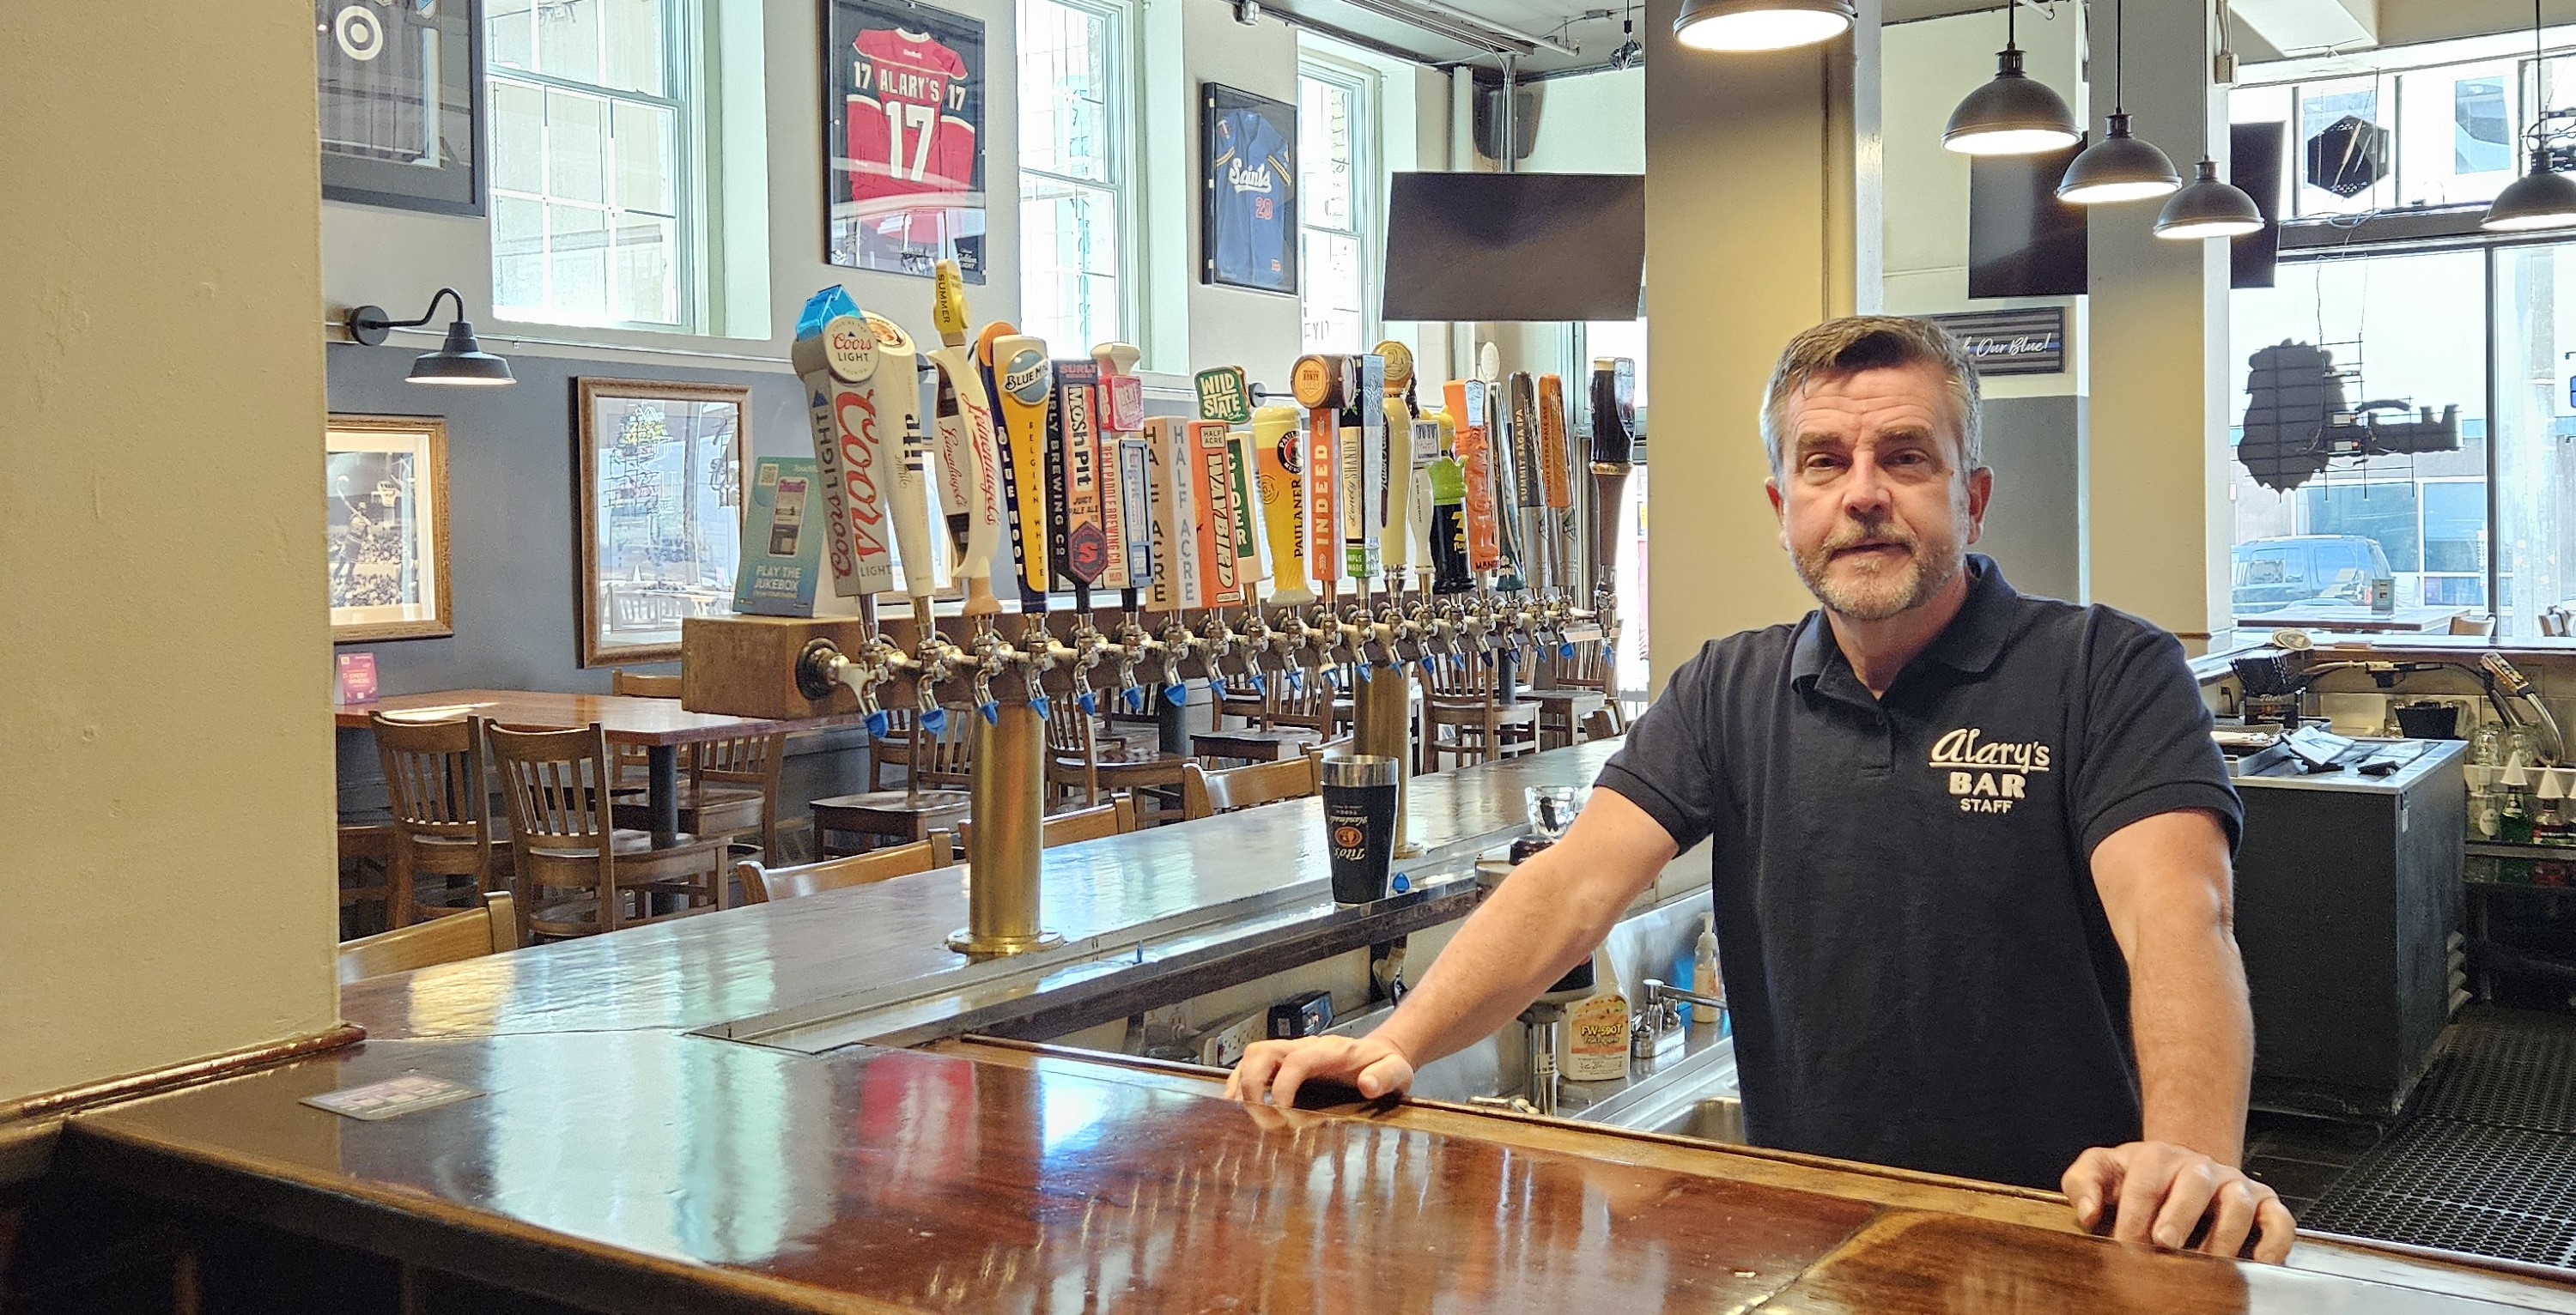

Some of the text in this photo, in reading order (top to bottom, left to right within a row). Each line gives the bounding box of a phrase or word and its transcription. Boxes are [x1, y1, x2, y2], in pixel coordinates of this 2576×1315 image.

[854, 61, 872, 90] 17
[879, 69, 939, 102] ALARY'S
[948, 84, 966, 112] 17
[885, 100, 935, 182] 17
[1229, 158, 1272, 193] Saints
[1255, 197, 1273, 220] 20
[938, 274, 951, 324] SUMMER
[831, 332, 872, 350] Coors
[1976, 338, 2008, 357] Our
[2008, 332, 2051, 356] Blue!
[838, 353, 869, 361] LIGHT
[1059, 363, 1097, 374] SURLY
[1005, 371, 1034, 391] BLUE
[1200, 373, 1236, 396] WILD
[1203, 392, 1242, 419] STATE
[1516, 409, 1524, 427] IPA
[998, 426, 1017, 498] BLUE
[1343, 439, 1358, 480] SHANDY
[835, 389, 887, 562] Coors
[1050, 439, 1064, 526] BREWING
[1517, 459, 1528, 501] SUMMIT
[815, 409, 853, 579] Coors LIGHT
[1029, 421, 1044, 577] BELGIAN WHITE
[1072, 496, 1092, 506] JUICY
[1227, 452, 1247, 546] CIDER
[1315, 444, 1329, 546] INDEED
[1086, 505, 1098, 513] ALE
[1173, 426, 1194, 601] HALF ACRE
[1206, 452, 1234, 589] WAYBIRD
[1291, 477, 1303, 558] PAULANER
[1105, 508, 1119, 550] BREWING
[754, 578, 800, 591] JUKEBOX
[756, 564, 802, 579] PLAY THE
[860, 565, 892, 578] LIGHT
[1929, 728, 2050, 774] Alary's
[1949, 771, 2026, 799] BAR
[1959, 797, 2014, 814] STAFF
[1333, 846, 1365, 862] Tito's
